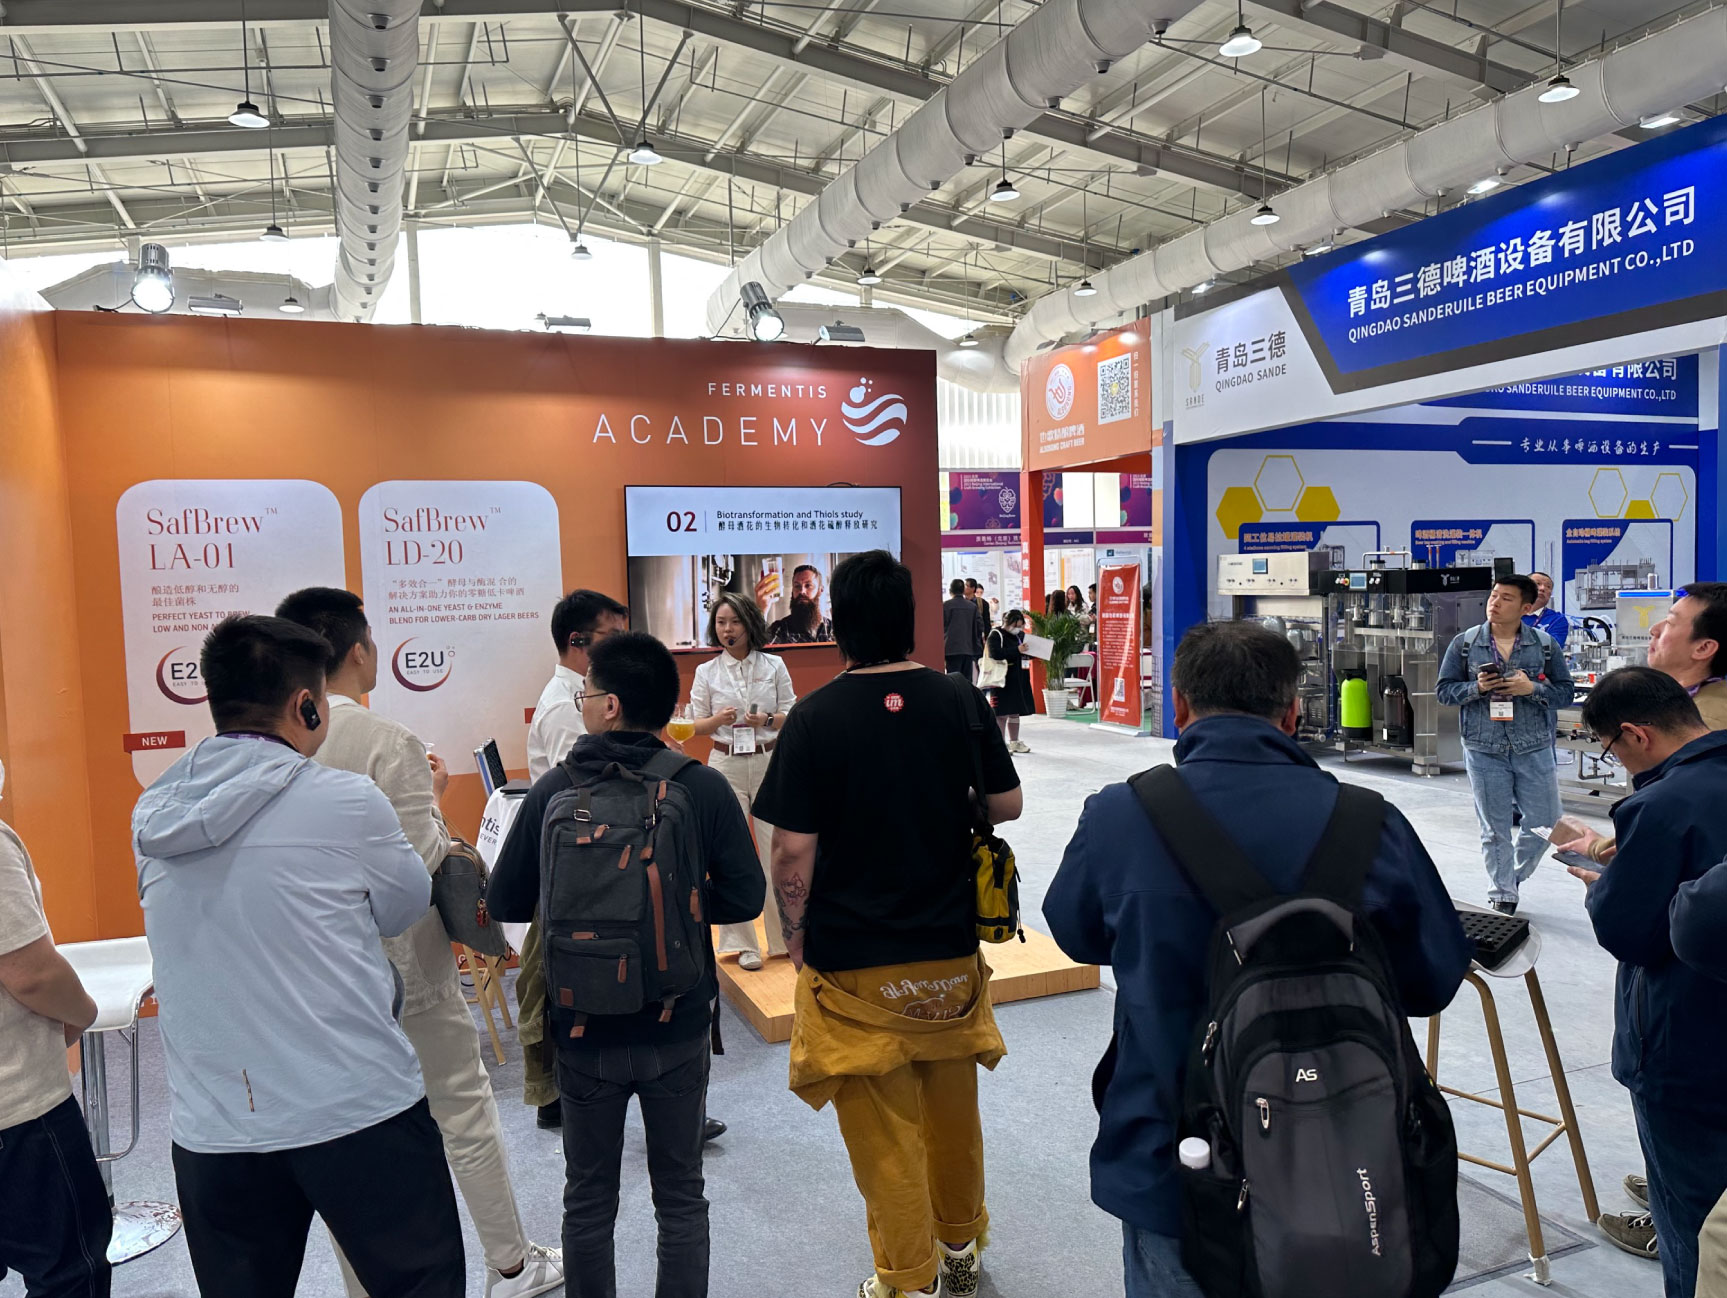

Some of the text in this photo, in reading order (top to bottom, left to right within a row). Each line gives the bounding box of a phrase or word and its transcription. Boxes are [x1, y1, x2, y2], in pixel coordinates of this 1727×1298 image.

[1348, 186, 1696, 318] 青岛三德啤酒设备有限公司
[1348, 239, 1695, 344] QINGDAO SANDERUILE BEER EQUIPMENT CO.,LTD
[1216, 330, 1286, 374] 青岛三德
[1216, 364, 1286, 392] QINGDAO SANDE
[708, 383, 827, 398] FERMENTIS
[1507, 384, 1564, 395] SANDERUILE
[1567, 386, 1589, 396] BEER
[1591, 387, 1642, 399] EQUIPMENT
[1644, 389, 1676, 402] CO.,LTD
[593, 414, 828, 446] ACADEMY
[1520, 437, 1660, 456] 专业从事啤酒设备的生产
[147, 508, 264, 535] SafBrew
[384, 507, 488, 532] SafBrew
[667, 511, 697, 532] 02
[717, 511, 794, 519] Biotransformation
[796, 511, 812, 519] and
[841, 511, 863, 520] study
[150, 543, 235, 570] LA-01
[386, 540, 463, 565] LD-20
[152, 584, 239, 595] 酿造低醇和无醇的
[388, 587, 524, 600] 解决方案助力你的零糖低卡啤酒
[152, 597, 196, 607] 最佳菌株
[401, 604, 442, 613] ALL-IN-ONE
[444, 603, 465, 611] YEAST
[474, 602, 502, 610] ENZYME
[152, 613, 186, 621] PERFECT
[431, 614, 476, 623] LOWER-CARB
[406, 651, 444, 668] E2U
[142, 736, 168, 746] NEW
